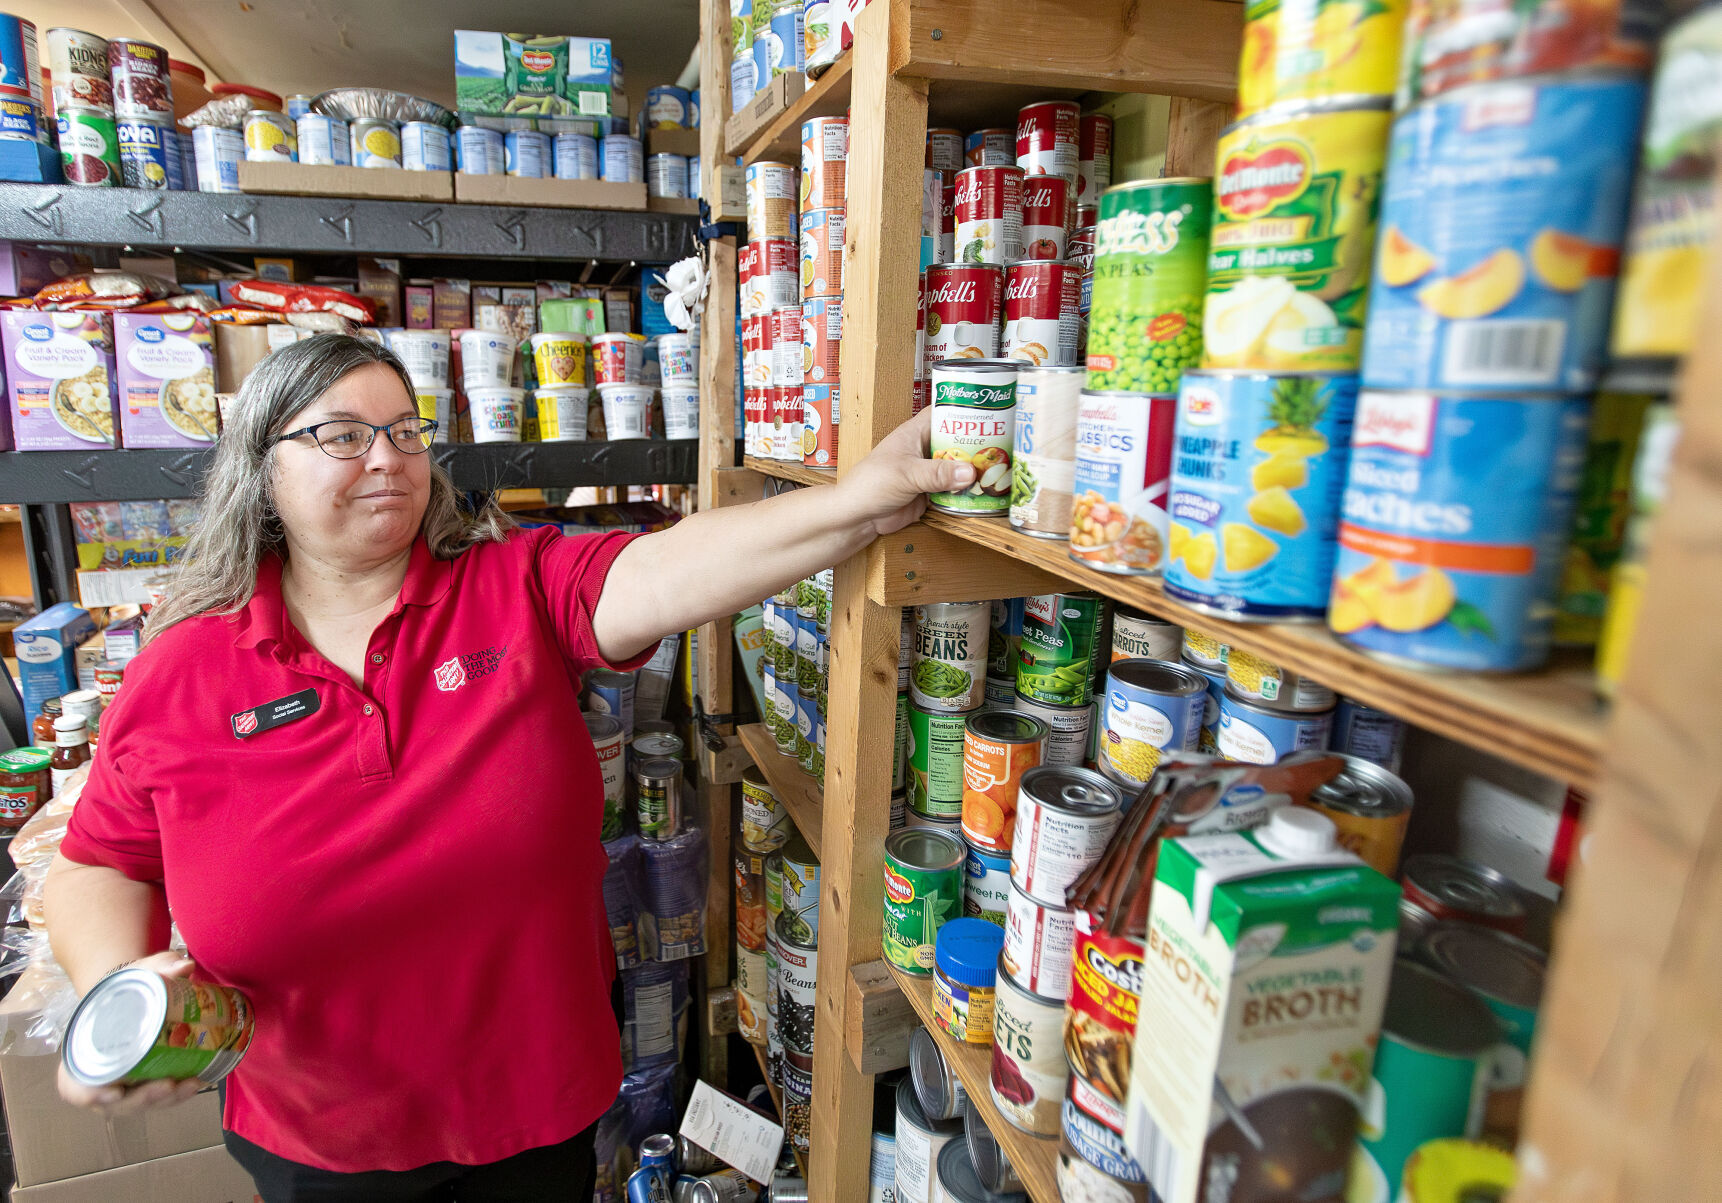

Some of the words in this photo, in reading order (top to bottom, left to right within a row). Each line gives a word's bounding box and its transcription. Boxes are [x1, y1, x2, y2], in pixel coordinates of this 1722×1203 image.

[69, 47, 107, 66] KIDNE
[592, 43, 607, 58] 12
[117, 124, 157, 143] OYA
[1239, 162, 1305, 190] Monte
[1021, 188, 1052, 208] bell's
[1239, 247, 1315, 268] Halves
[1106, 261, 1153, 278] PEAS
[925, 281, 976, 308] mpbell's
[1005, 277, 1039, 300] bell's
[24, 346, 43, 354] Fruit
[938, 343, 947, 351] of
[663, 364, 693, 376] Crunch
[937, 384, 981, 401] Mother's
[974, 387, 1013, 404] Maid
[939, 420, 1007, 437] APPLE
[953, 436, 986, 446] Sauce
[1076, 431, 1135, 452] ASSICS
[1343, 491, 1473, 534] aches
[122, 548, 158, 565] Fun
[916, 625, 969, 639] GREEN
[926, 617, 950, 629] french
[950, 620, 970, 632] style
[1119, 626, 1147, 640] sliced
[775, 634, 790, 642] eans
[915, 631, 969, 661] BEANS
[1035, 628, 1065, 648] Peas
[461, 646, 497, 664] DOING
[463, 660, 486, 672] THE
[486, 644, 508, 665] MOST
[800, 647, 816, 656] eans
[467, 661, 500, 680] GOOD
[272, 711, 287, 720] Social
[286, 705, 306, 715] Services
[275, 700, 301, 713] Elizabeth
[776, 707, 790, 716] eans
[931, 722, 954, 730] Nutrition
[1134, 722, 1164, 734] Kernel
[597, 746, 619, 760] OVER
[973, 739, 1005, 756] CARROTS
[1045, 822, 1070, 835] Facts
[1046, 816, 1085, 831] Nutrition
[995, 891, 1009, 901] Pe
[1049, 916, 1074, 926] Nutrit
[891, 928, 918, 948] BEANS
[777, 946, 806, 966] NOVER
[1154, 915, 1223, 989] VEGETABLE
[1150, 928, 1220, 1016] BROTH
[1246, 966, 1364, 993] VEGETABLE
[1242, 986, 1363, 1028] BROTH
[995, 1013, 1033, 1061] ETS
